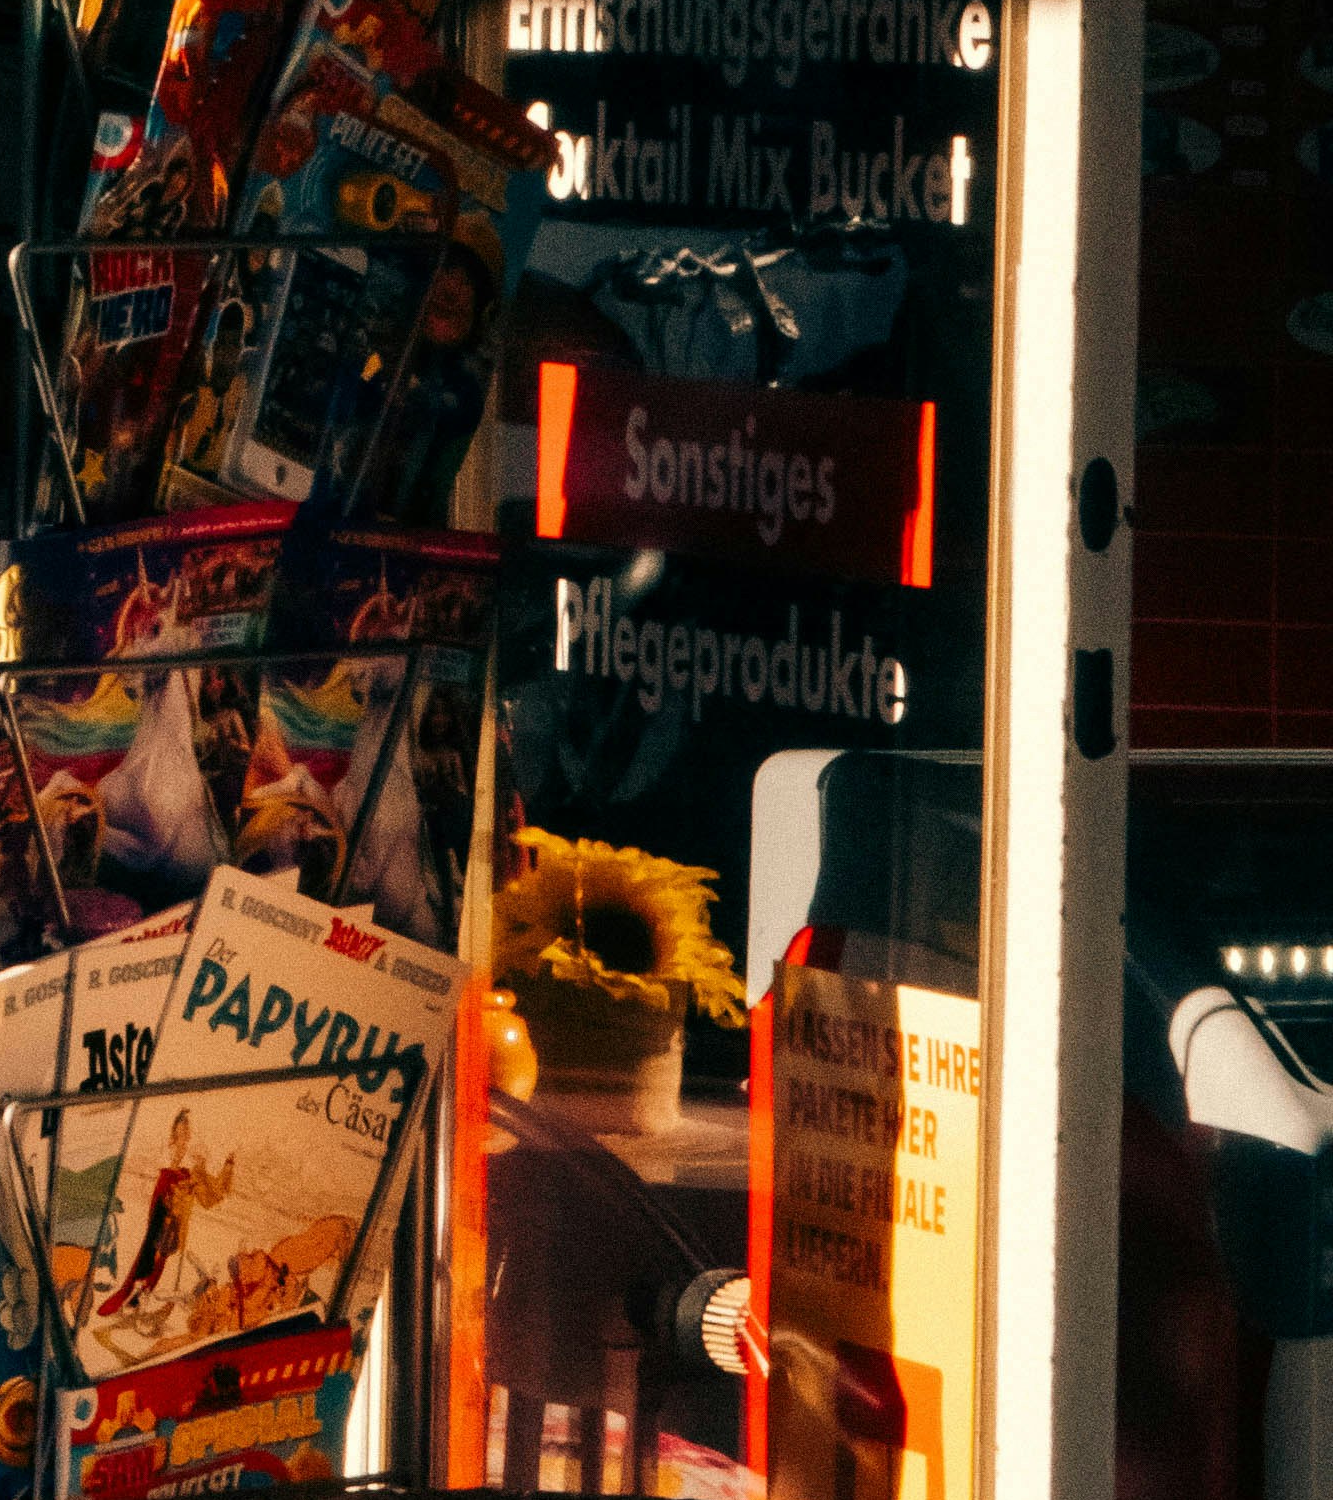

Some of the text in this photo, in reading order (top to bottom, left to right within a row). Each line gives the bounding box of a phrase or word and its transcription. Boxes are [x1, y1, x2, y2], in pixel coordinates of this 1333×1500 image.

[707, 111, 794, 211] Mix
[808, 114, 973, 227] Bucket
[623, 406, 837, 548] Sonstiges
[555, 576, 909, 725] Pflegeprodukte
[181, 959, 426, 1105] PAPYRUS
[927, 1037, 981, 1097] IHRE
